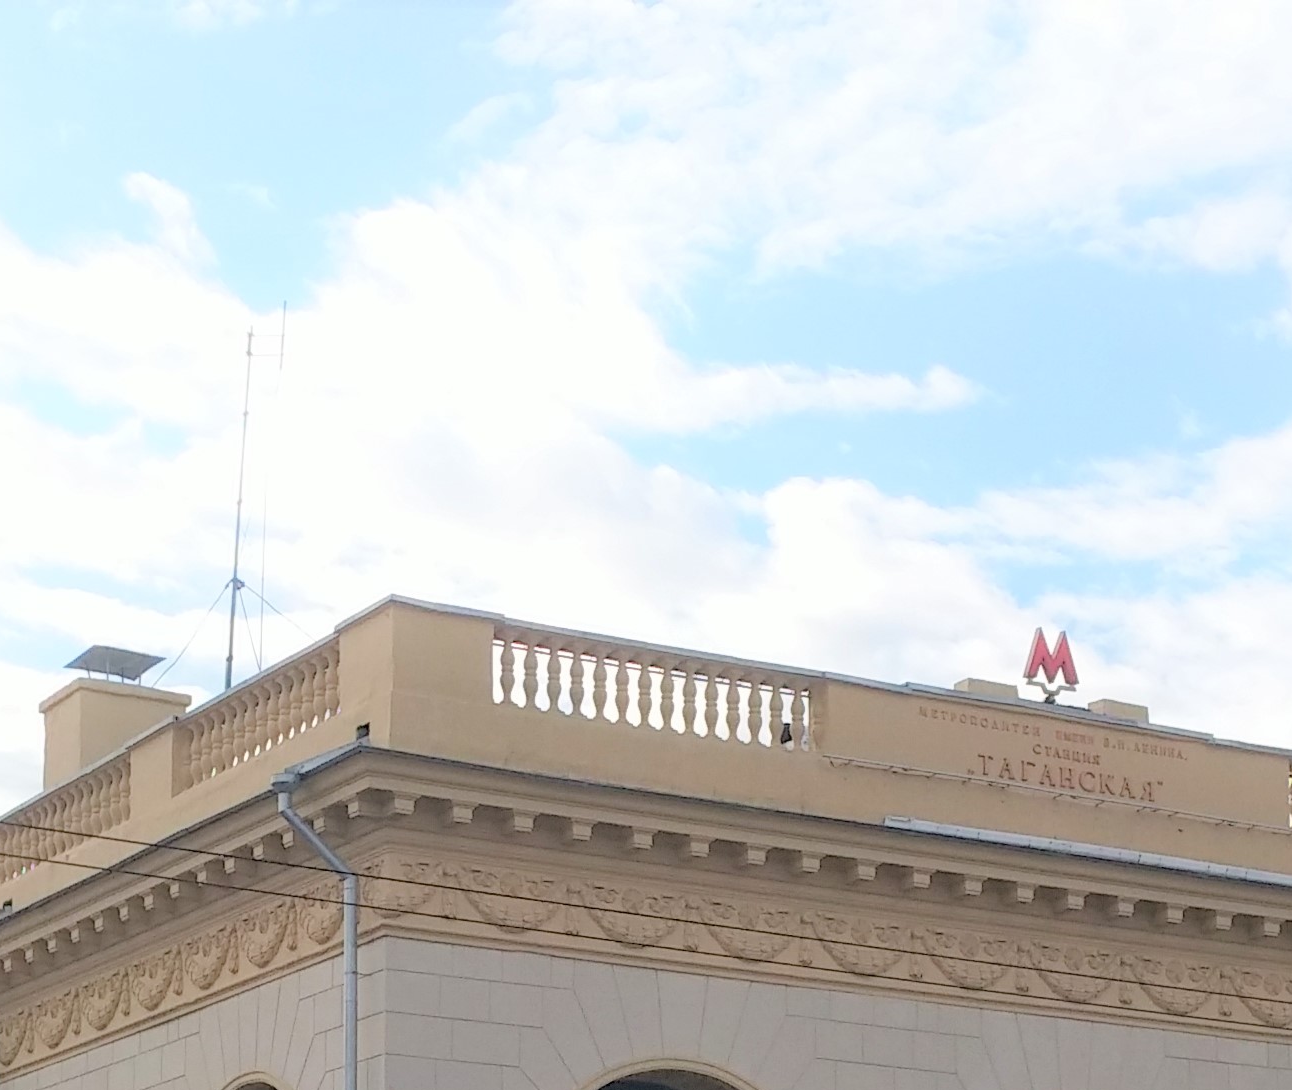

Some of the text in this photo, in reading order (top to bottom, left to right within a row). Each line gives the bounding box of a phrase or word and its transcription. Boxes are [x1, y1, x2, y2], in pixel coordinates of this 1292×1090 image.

[1023, 627, 1079, 685] М
[918, 705, 1042, 737] МЕТРОПОЛИТЕН
[1032, 744, 1101, 766] СТАНЦИЯ
